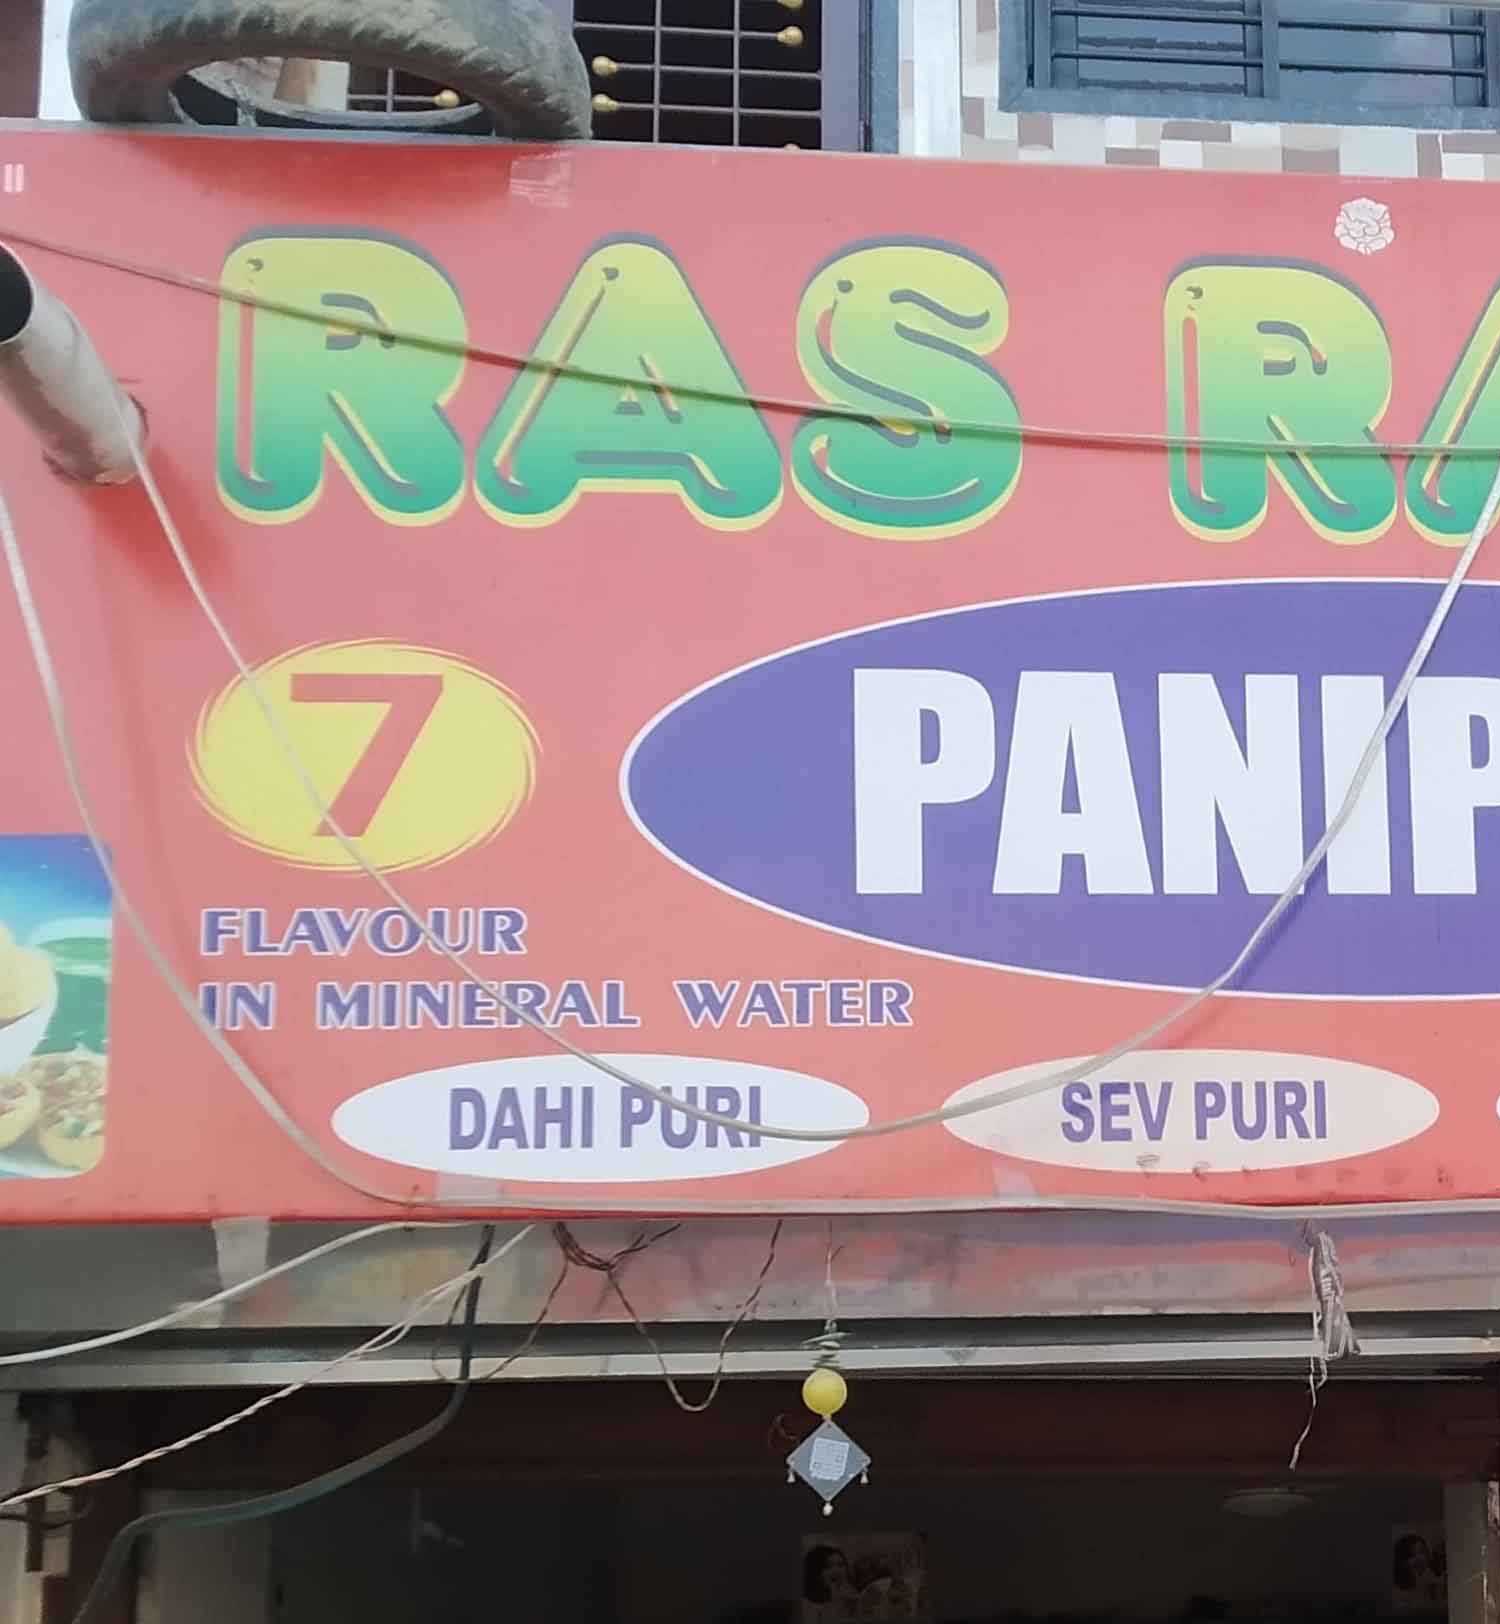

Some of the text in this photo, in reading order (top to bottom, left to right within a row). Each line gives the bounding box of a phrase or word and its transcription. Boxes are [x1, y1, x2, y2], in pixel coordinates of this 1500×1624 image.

[216, 226, 1022, 541] RAS
[289, 673, 444, 838] 7
[201, 907, 527, 957] FLAVOUR
[201, 980, 913, 1031] IN MINERAL WATER
[449, 1084, 762, 1151] DAHI PURI
[1061, 1080, 1327, 1143] SEV PURI
